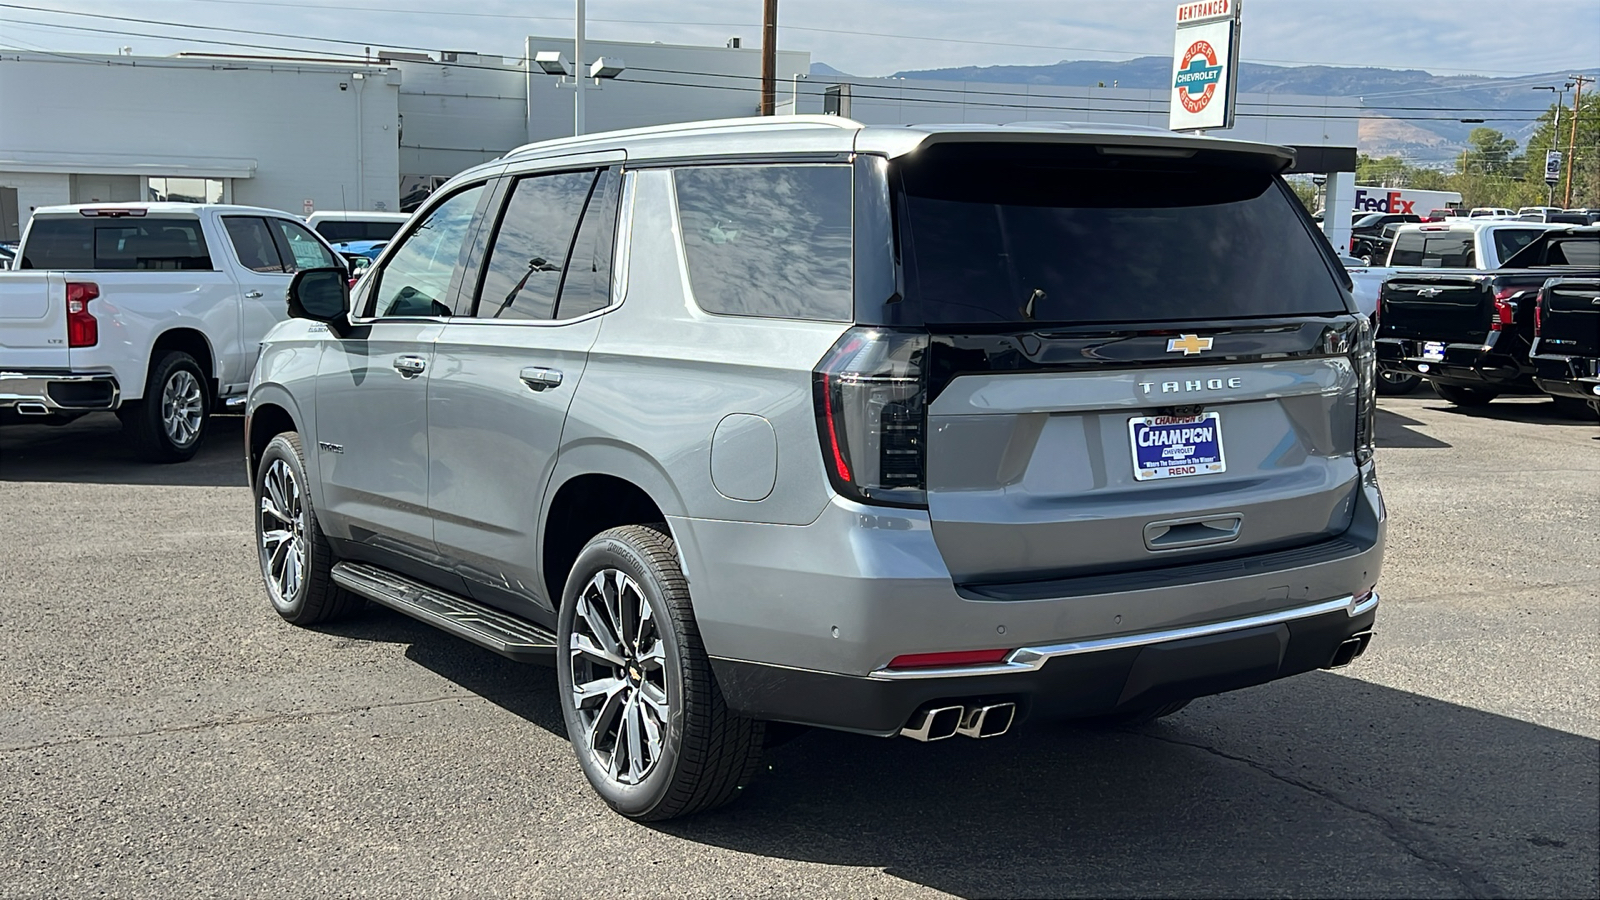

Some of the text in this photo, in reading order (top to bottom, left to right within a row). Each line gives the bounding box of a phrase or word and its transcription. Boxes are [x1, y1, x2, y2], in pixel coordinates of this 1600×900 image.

[1183, 0, 1223, 20] ENTRANCE
[1185, 42, 1212, 61] SUPER
[1177, 70, 1218, 83] CHEVROLET
[1180, 88, 1212, 111] SERVICE
[1354, 189, 1416, 215] FedEx
[1138, 377, 1242, 394] TAHOE
[1138, 427, 1213, 447] CHAMPION
[1163, 447, 1193, 456] CHEVROLET
[1168, 466, 1196, 476] RENO
[607, 542, 647, 577] BRIDGESTONE
